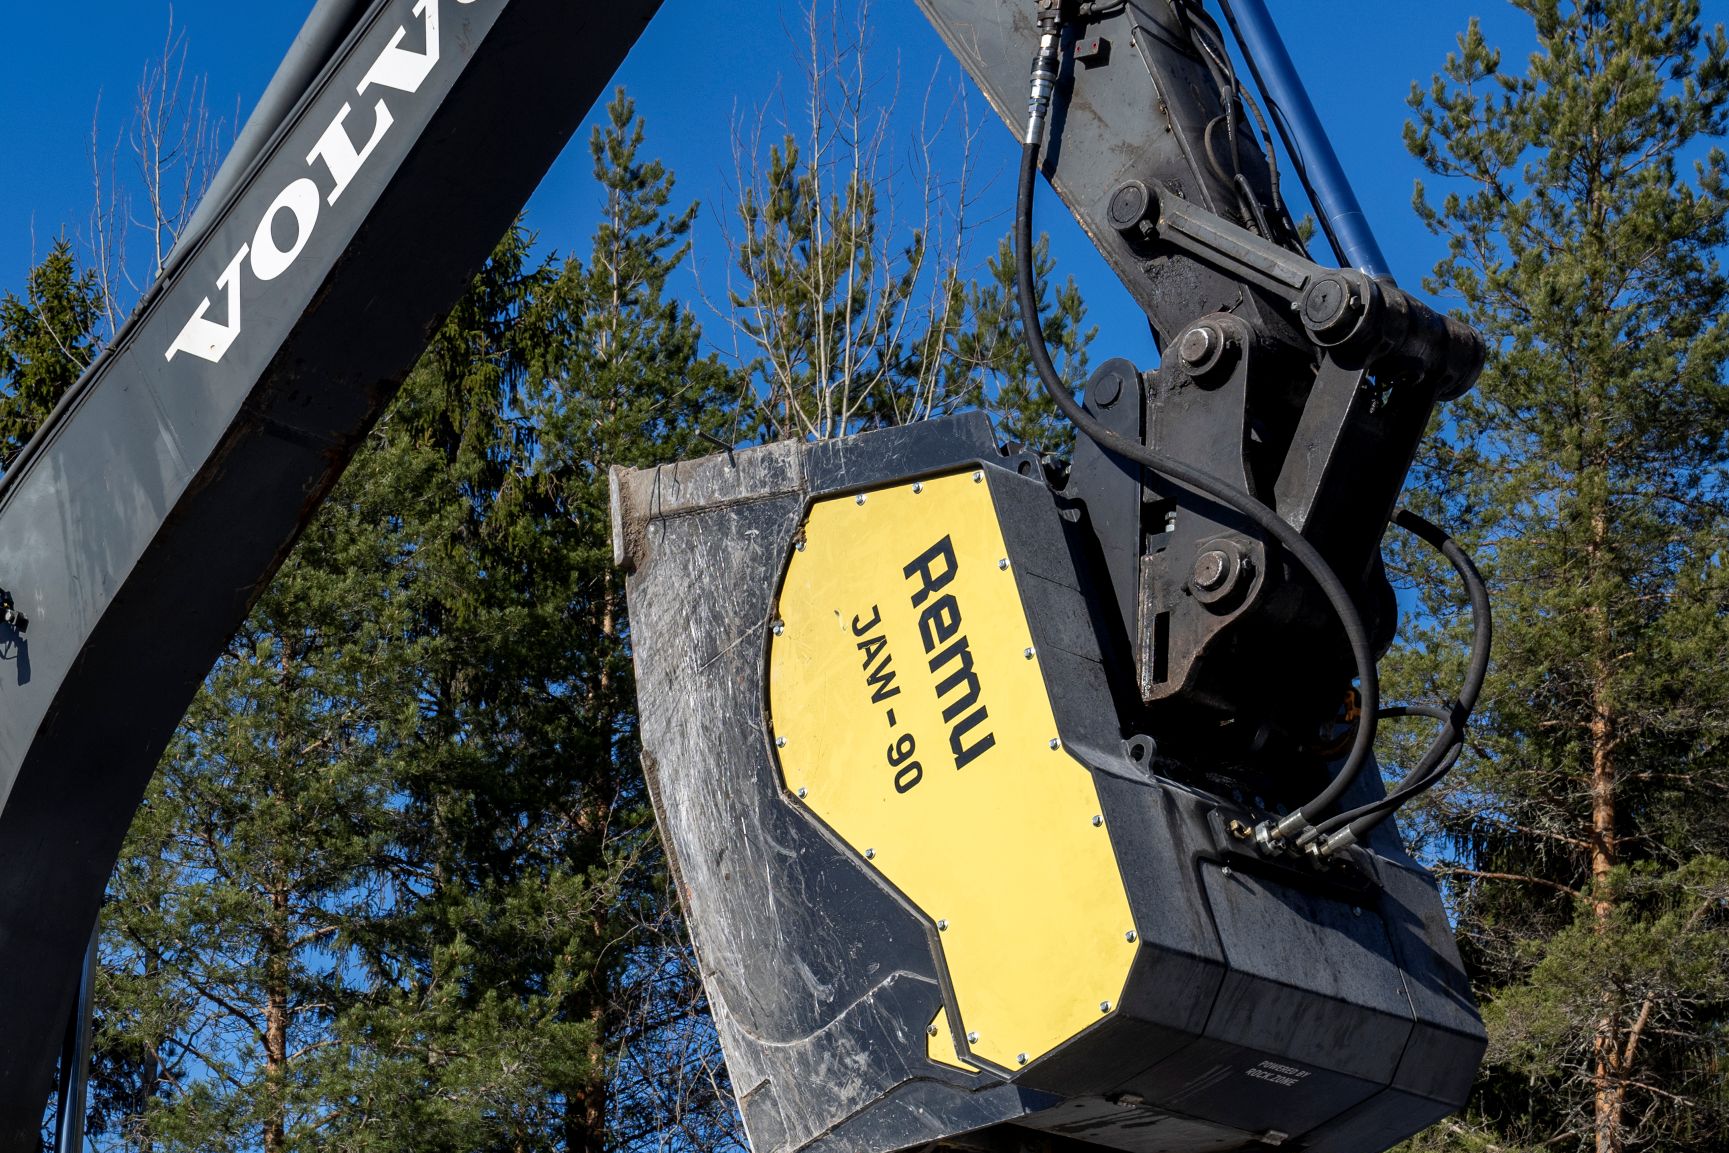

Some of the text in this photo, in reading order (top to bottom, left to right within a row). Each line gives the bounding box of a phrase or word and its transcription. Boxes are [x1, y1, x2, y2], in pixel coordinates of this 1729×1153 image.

[165, 0, 476, 363] VOLV
[851, 604, 923, 794] JAW-90
[903, 534, 996, 771] Remu
[1257, 1060, 1312, 1078] POWERED BY
